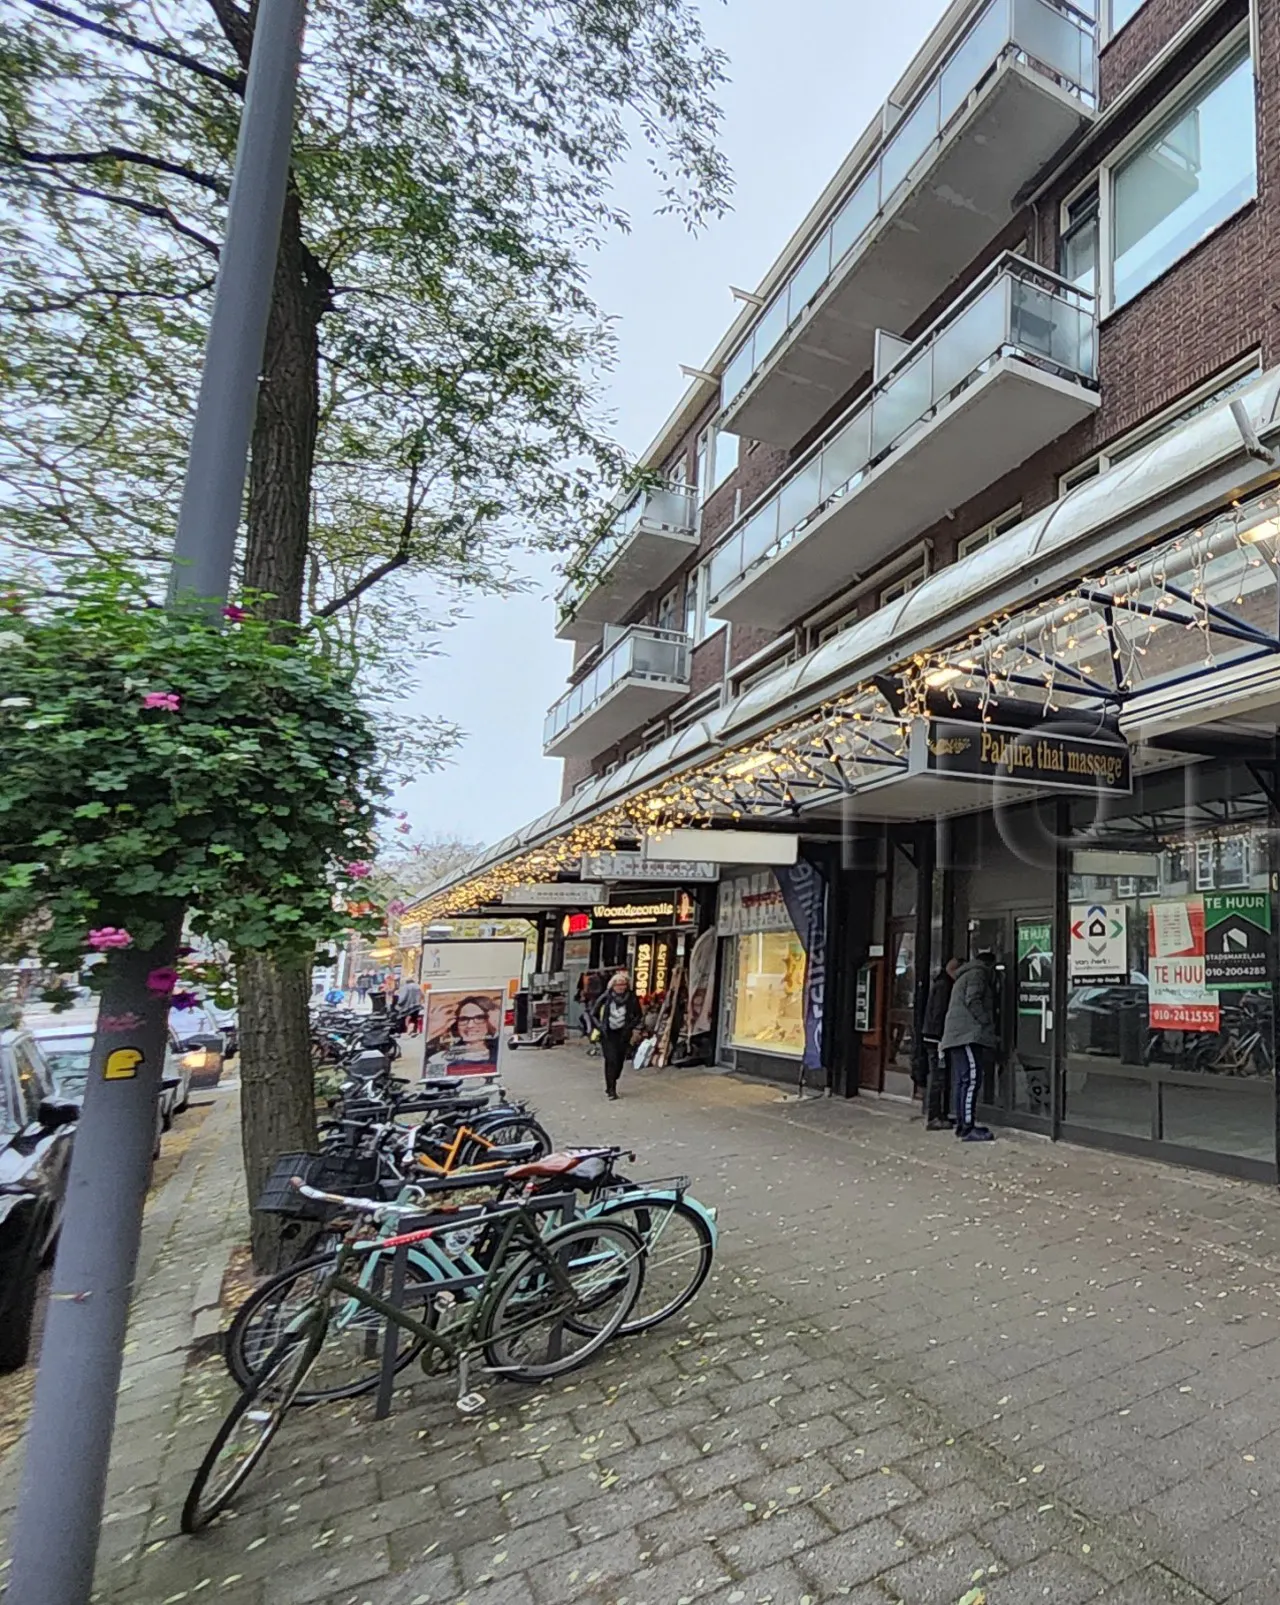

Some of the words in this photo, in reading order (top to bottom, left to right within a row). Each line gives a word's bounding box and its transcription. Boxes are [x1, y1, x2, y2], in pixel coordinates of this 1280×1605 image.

[981, 732, 1033, 773] Pakjira
[1037, 742, 1064, 770] thai
[1067, 753, 1122, 784] massage
[1205, 897, 1222, 908] TE
[1225, 896, 1265, 908] HUUR
[1155, 966, 1169, 983] TE
[1174, 965, 1203, 984] HUU
[1205, 966, 1267, 977] 010-2004285
[1153, 1009, 1215, 1023] 010-2411555
